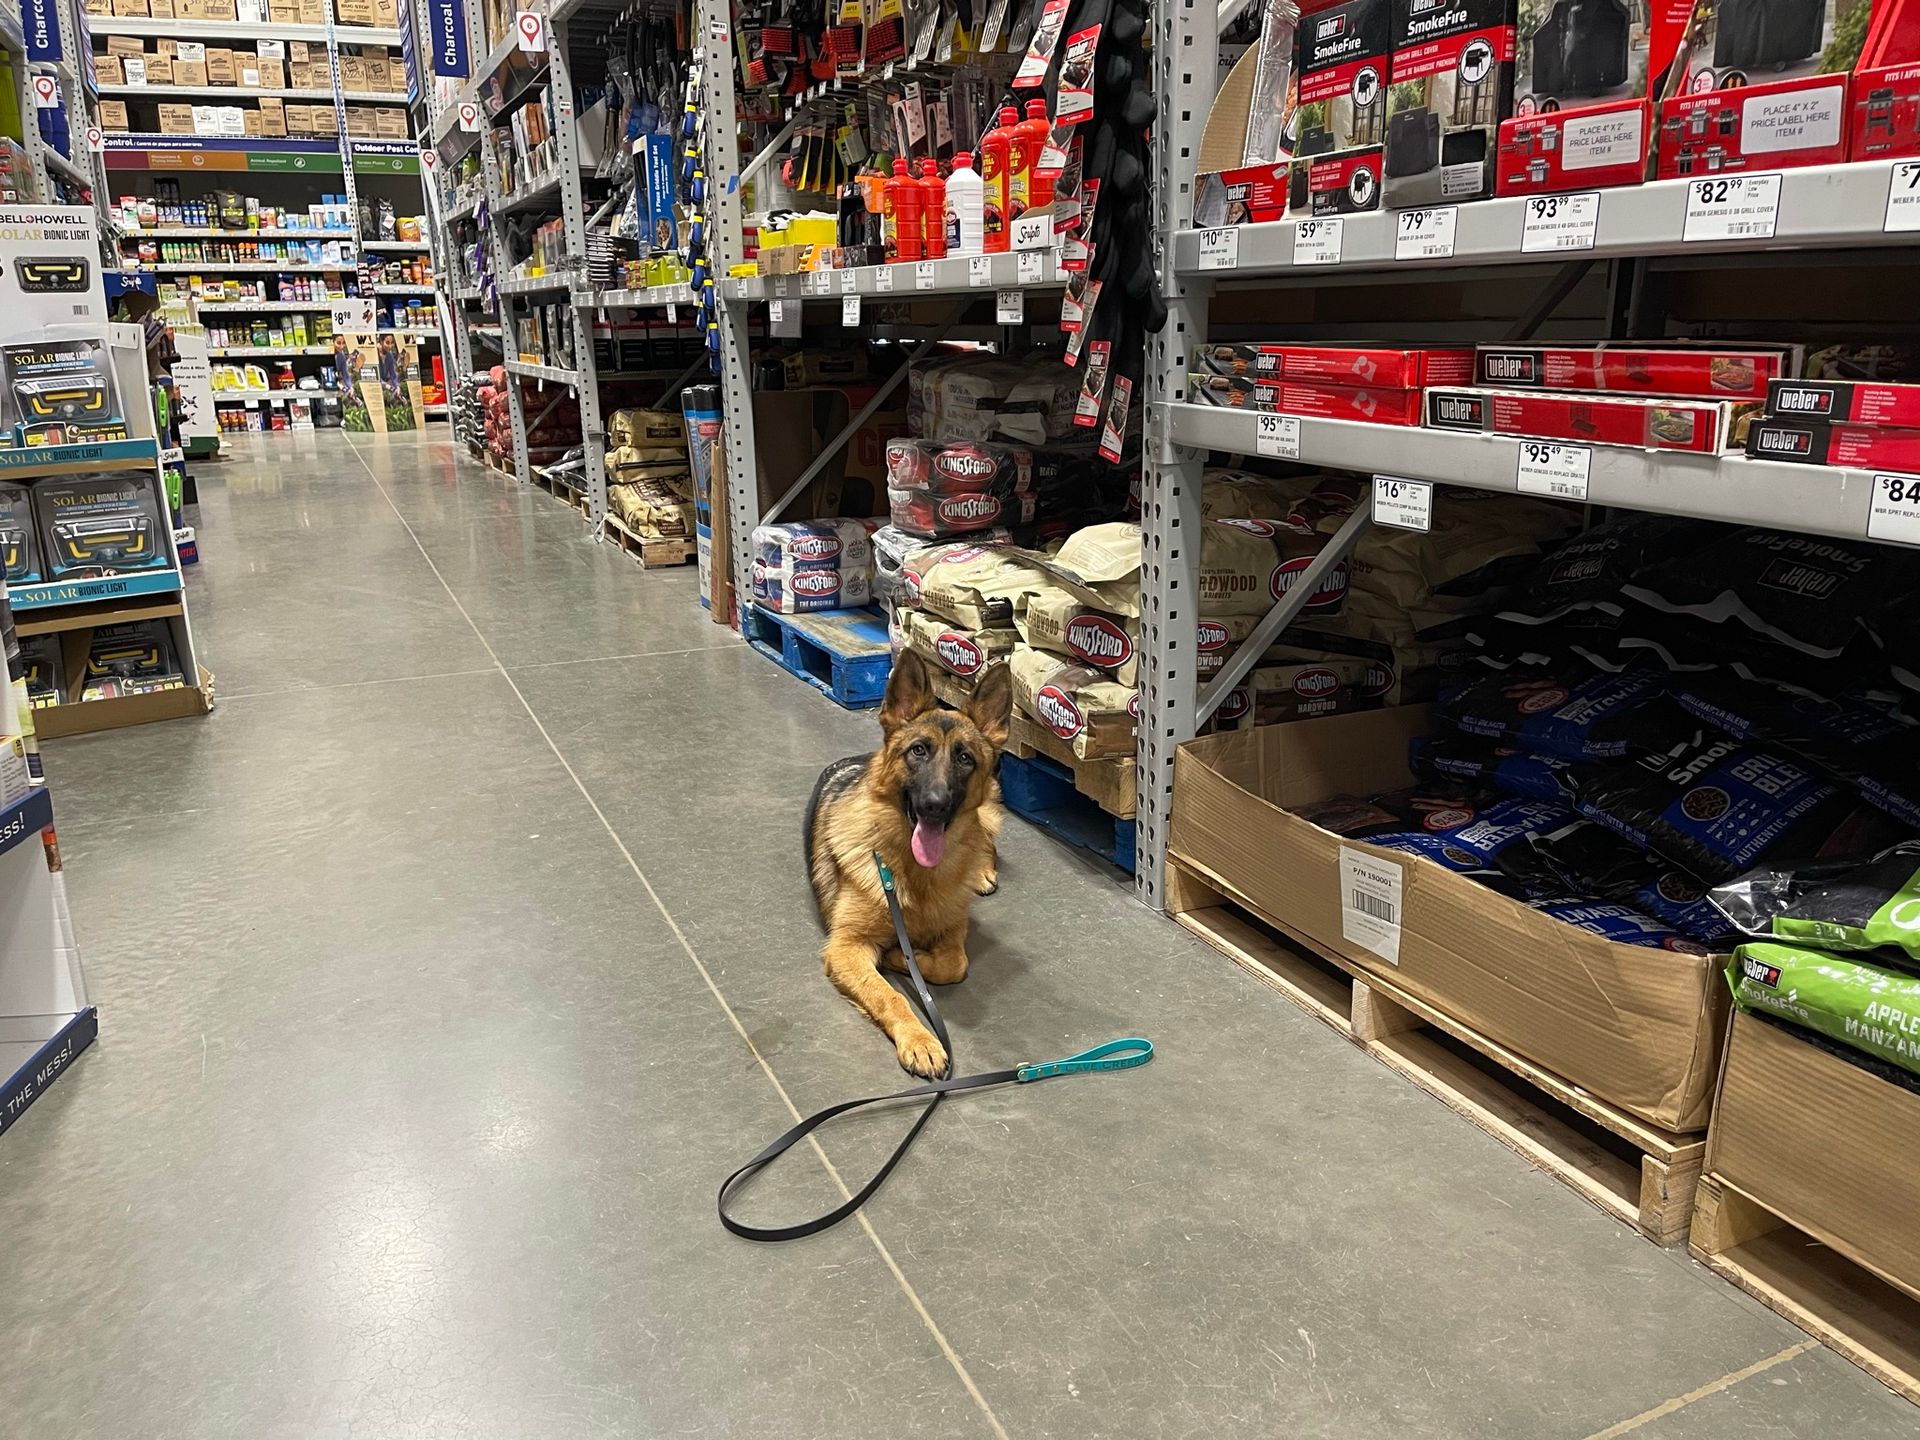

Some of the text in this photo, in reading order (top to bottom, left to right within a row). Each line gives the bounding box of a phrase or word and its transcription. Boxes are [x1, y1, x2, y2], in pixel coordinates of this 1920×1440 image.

[1318, 18, 1338, 38] weber
[1407, 10, 1468, 36] SmokeFire
[440, 3, 456, 66] Charcoal
[1313, 37, 1361, 60] SmokeFire
[1410, 48, 1423, 59] GRILL
[1423, 45, 1439, 55] COVER
[1694, 99, 1707, 108] APTO
[1708, 97, 1721, 107] PARA
[1763, 103, 1790, 116] PLACE
[1792, 102, 1801, 112] 4"
[1802, 102, 1809, 111] X
[1751, 111, 1831, 129] PRICE LABEL HERE
[1579, 126, 1602, 136] PLACE
[1603, 124, 1610, 132] 4"
[1610, 123, 1616, 131] X
[1775, 127, 1804, 138] ITEM #
[103, 138, 134, 147] Control
[1569, 131, 1633, 147] PRICE LABEL HERE
[354, 144, 385, 152] Outdoor
[386, 145, 403, 153] Pest
[1589, 146, 1606, 155] ITEM
[1442, 183, 1449, 194] 3
[1748, 178, 1769, 186] Everyday
[1893, 196, 1915, 204] WEBER
[1689, 205, 1774, 217] WEBER GENESIS GRILL COVER
[0, 229, 90, 240] OLAR BIONIC LIGHT
[1017, 224, 1041, 245] Scripto
[14, 351, 92, 365] SOLAR BIONIC LIGHT
[1257, 354, 1276, 369] weber
[1488, 355, 1522, 377] weber
[1255, 386, 1274, 401] weber
[1781, 389, 1819, 410] weber
[1440, 398, 1472, 420] weber
[1762, 430, 1799, 450] weber
[0, 447, 103, 465] SOLAR BIONIC LIGHT
[939, 456, 992, 477] KINGSFORD
[53, 491, 137, 507] SOLAR BIONIC LIGHT
[944, 499, 997, 518] KINGSFORD
[793, 539, 838, 556] KINGSFORD
[794, 575, 838, 592] KINGSFORD
[1199, 575, 1257, 592] RDWOOD
[1277, 568, 1347, 593] KINORD
[25, 588, 77, 603] SOLAR
[78, 584, 105, 596] BIONIC
[106, 582, 128, 592] LIGHT
[1068, 624, 1123, 657] KINGSFORD
[1197, 625, 1227, 645] GSFORD
[938, 639, 976, 666] KINGSFORD
[1197, 656, 1223, 667] DWOOD
[1296, 674, 1337, 691] KINGSFORD
[1297, 701, 1337, 713] HARDWOOD
[1733, 816, 1789, 865] AUTHENTIC
[1786, 794, 1818, 821] WOOD
[1353, 866, 1366, 877] P/N
[1740, 976, 1809, 1020] SmokeFire
[1864, 1001, 1920, 1035] APPLE
[1065, 1062, 1097, 1073] CAVE
[7, 1038, 74, 1115] THE MESS!
